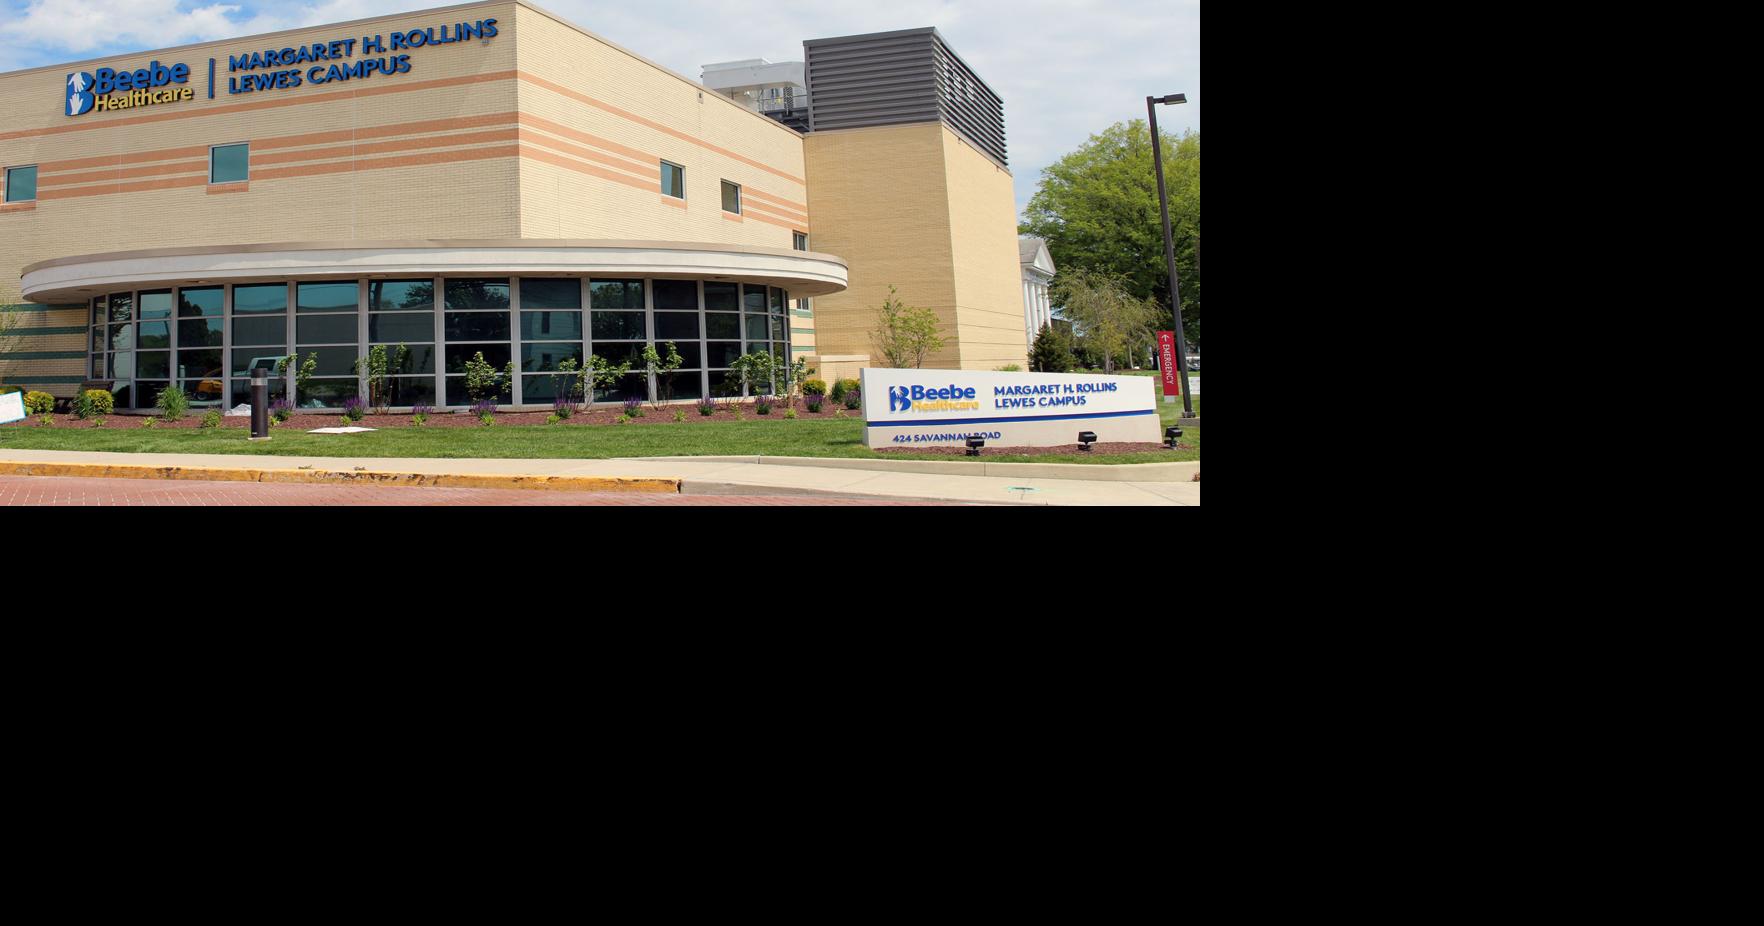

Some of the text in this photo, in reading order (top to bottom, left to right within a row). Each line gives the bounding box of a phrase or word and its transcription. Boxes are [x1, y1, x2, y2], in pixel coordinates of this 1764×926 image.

[228, 38, 355, 72] MARGARET
[390, 18, 498, 50] ROLLINS
[95, 60, 190, 95] Beebe
[228, 54, 412, 94] LEWES CAMPUS
[94, 87, 194, 112] Healthcare
[1163, 344, 1174, 384] EMERGENCY
[911, 383, 976, 400] Beebe
[994, 384, 1061, 396] MARGARET
[1076, 382, 1117, 393] ROLLINS
[911, 399, 980, 412] Healthcare
[995, 395, 1087, 409] LEWES CAMPUS
[892, 434, 912, 443] 424
